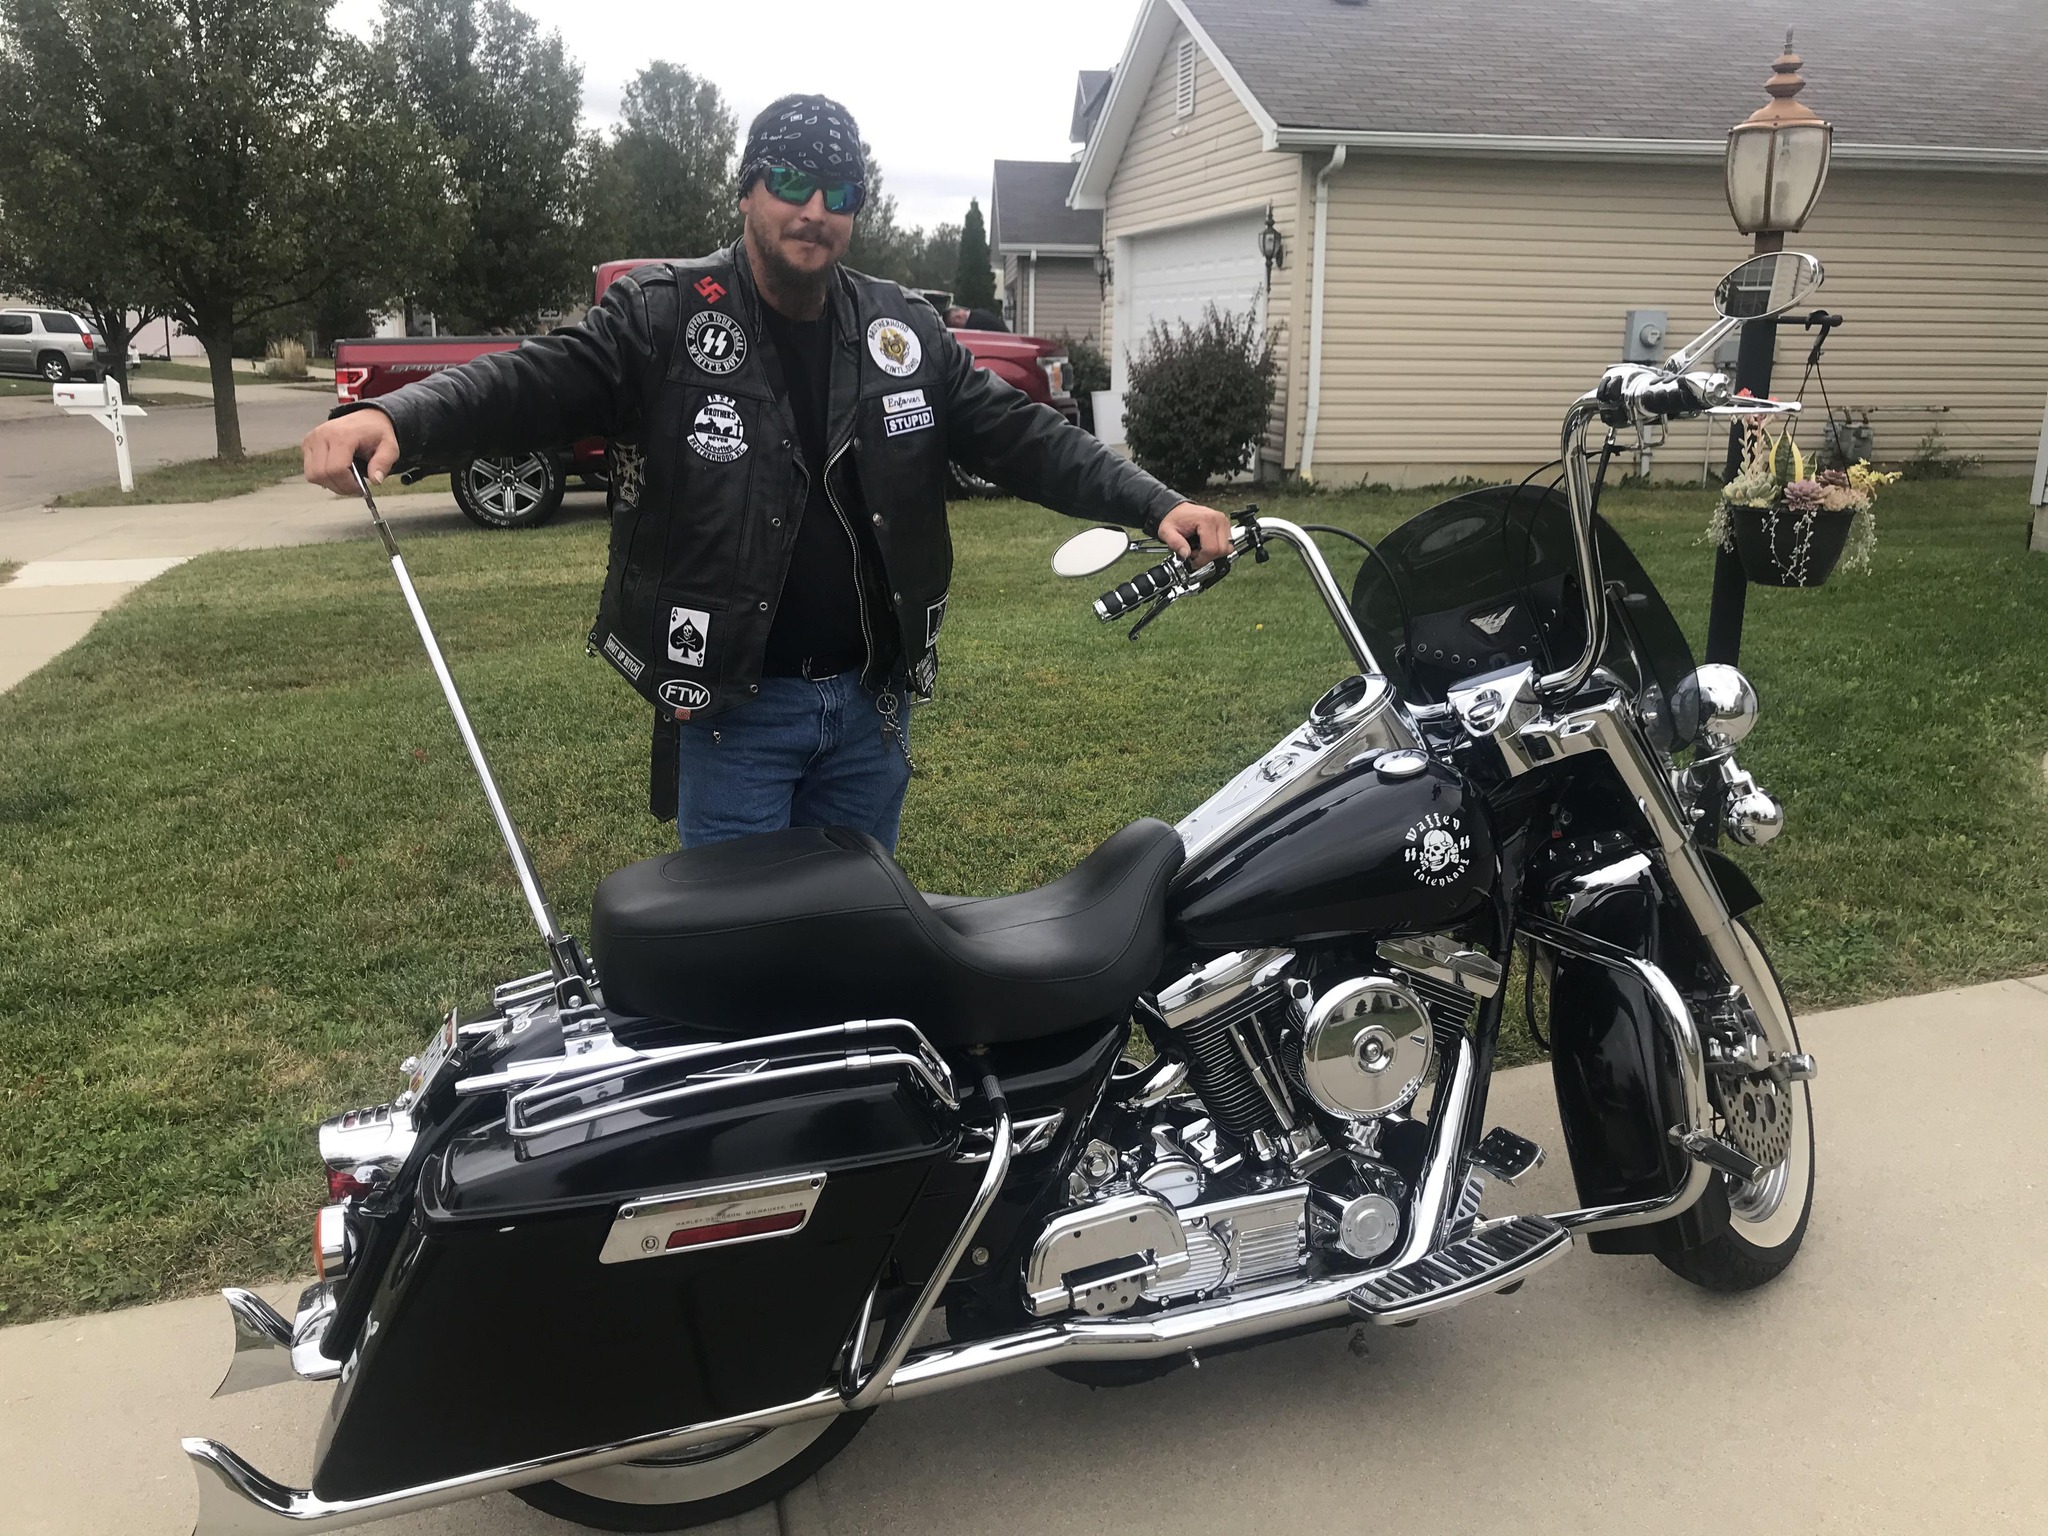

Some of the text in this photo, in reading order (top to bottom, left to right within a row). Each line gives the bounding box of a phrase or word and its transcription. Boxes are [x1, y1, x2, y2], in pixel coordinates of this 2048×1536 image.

[688, 313, 744, 351] SUPPORT YOUR LOCAL
[869, 320, 909, 340] BROTHERHOOD
[690, 343, 740, 371] WHITE BOY
[111, 396, 124, 447] 5719
[704, 406, 736, 420] BROTHERS
[889, 412, 930, 432] STUPID
[623, 655, 640, 675] BITCH
[665, 685, 706, 704] FTW
